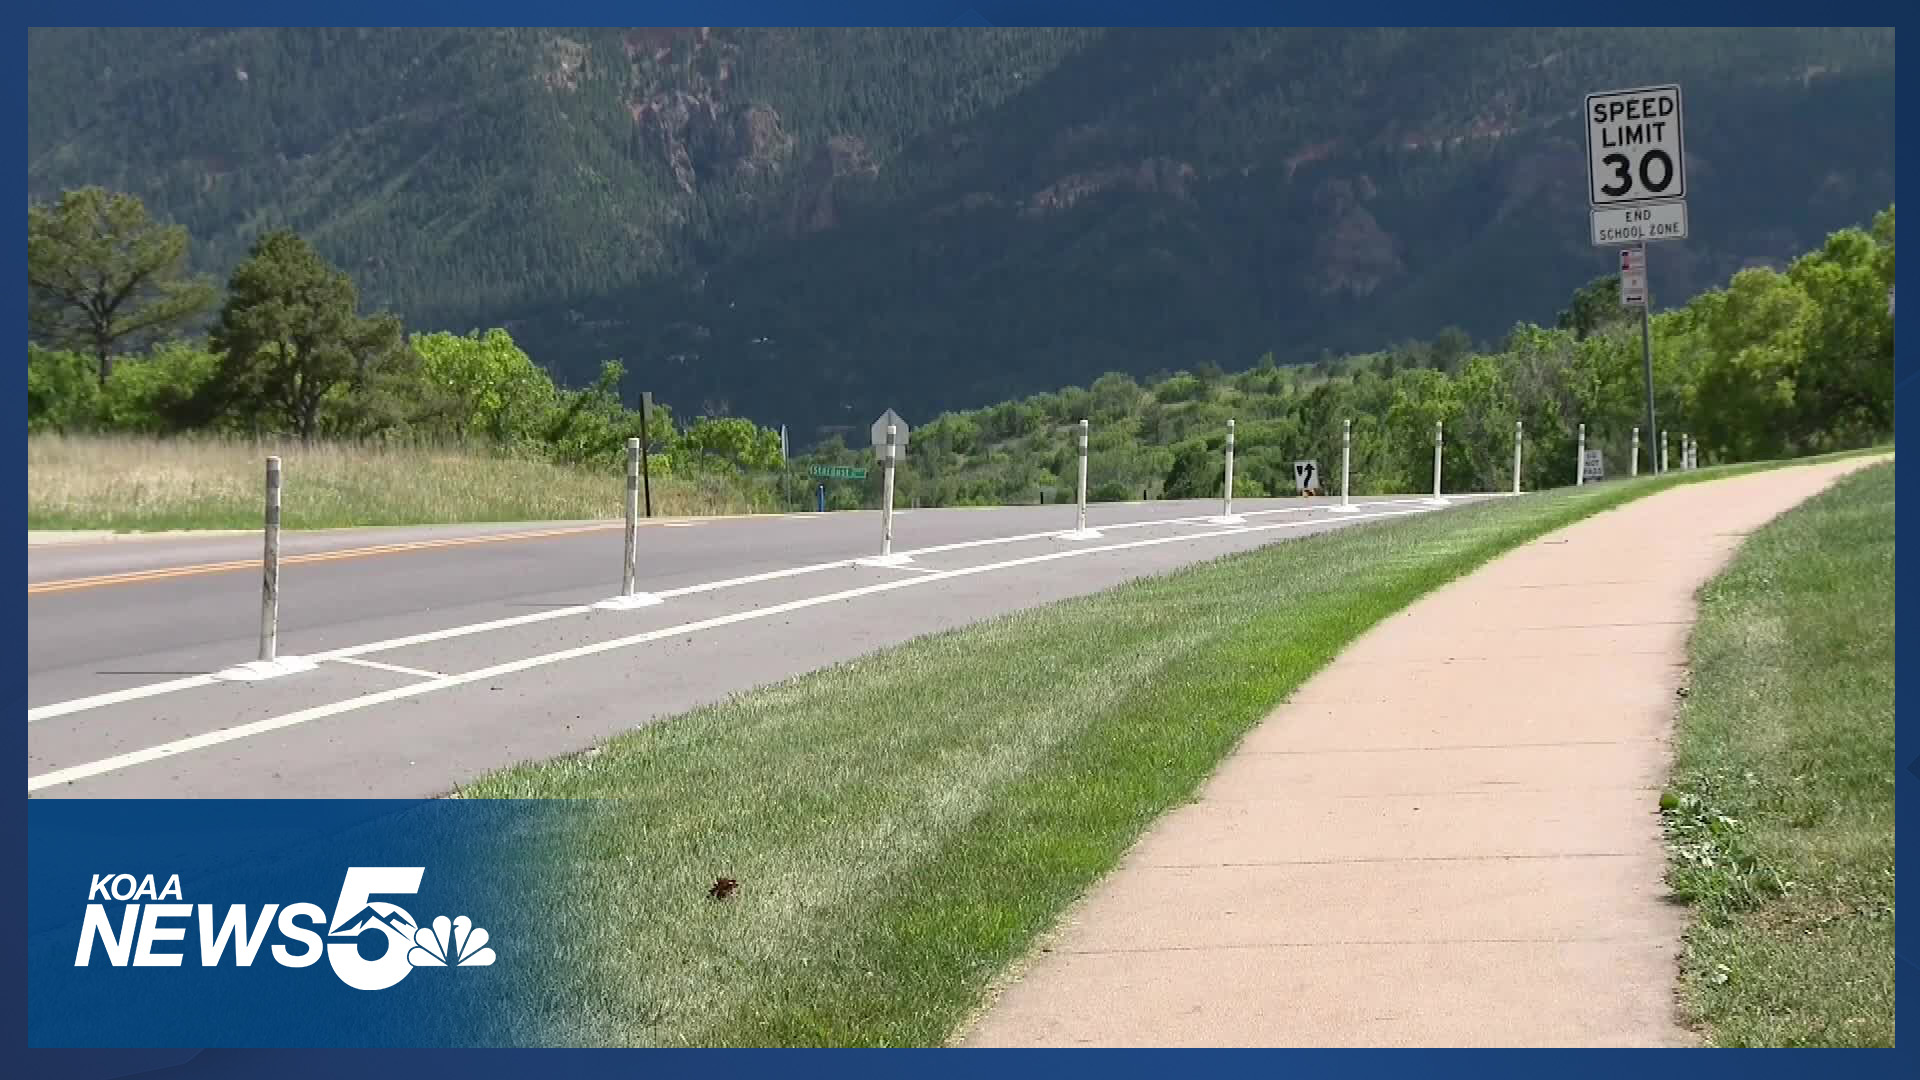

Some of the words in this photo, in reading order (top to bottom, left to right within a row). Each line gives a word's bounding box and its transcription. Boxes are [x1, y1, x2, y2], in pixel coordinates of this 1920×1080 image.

[1594, 97, 1673, 122] SPEED
[1602, 122, 1665, 148] LIMIT
[1601, 150, 1673, 197] 30
[1625, 210, 1651, 222] END
[1600, 227, 1645, 241] SCHOOL
[1649, 222, 1680, 235] ZONE
